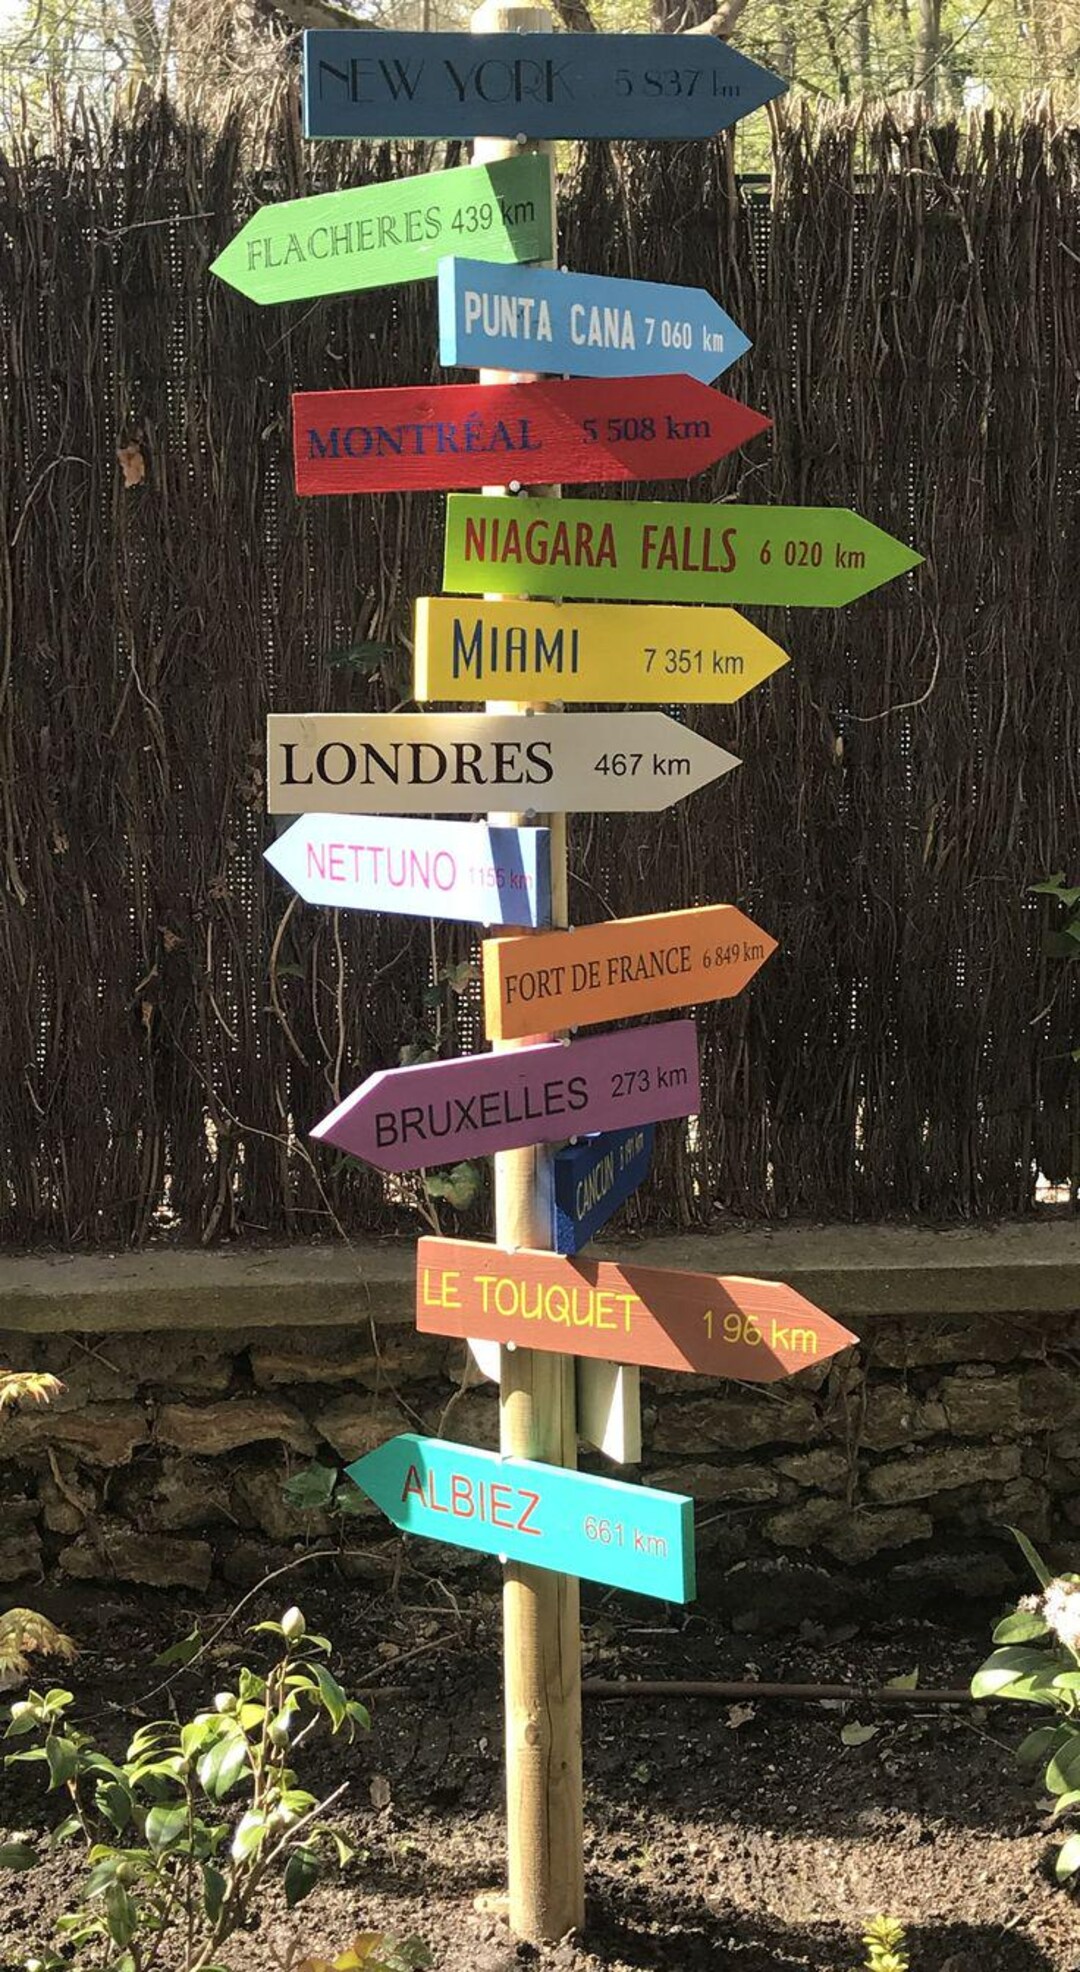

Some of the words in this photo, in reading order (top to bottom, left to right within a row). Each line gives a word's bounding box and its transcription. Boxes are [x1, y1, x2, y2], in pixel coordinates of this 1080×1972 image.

[319, 58, 425, 103] NEW
[443, 59, 577, 104] YORK
[615, 69, 633, 97] 5
[644, 69, 703, 97] 837
[246, 206, 444, 271] FLACHERES
[451, 203, 495, 235] 439
[501, 200, 536, 226] km
[464, 290, 552, 342] PUNTA
[570, 303, 636, 350] CANA
[644, 317, 656, 346] 7
[661, 320, 692, 350] 060
[703, 325, 724, 353] km
[305, 412, 542, 459] MONTRÉAL
[582, 419, 598, 445] 5
[607, 418, 657, 442] 508
[665, 415, 711, 440] km
[464, 517, 618, 568] NIAGARA
[640, 525, 737, 573] FALLS
[759, 539, 772, 566] 6
[784, 540, 823, 568] 020
[835, 543, 866, 570] km
[644, 648, 657, 673] 7
[664, 648, 703, 674] 351
[712, 650, 745, 675] km
[279, 741, 555, 786] LONDRES
[594, 753, 641, 776] 467
[653, 753, 691, 776] km
[306, 842, 457, 892] NETTUNO
[509, 870, 534, 891] km
[504, 966, 566, 1005] FORT
[571, 960, 600, 993] DE
[606, 945, 692, 987] FRANCE
[702, 952, 712, 969] 6
[714, 947, 740, 968] 849
[743, 940, 765, 963] km
[374, 1076, 589, 1148] BRUXELLES
[610, 1069, 650, 1098] 273
[656, 1066, 688, 1089] km
[423, 1268, 462, 1308] LE
[474, 1275, 642, 1332] TOUQUET
[770, 1318, 818, 1354] km
[401, 1464, 542, 1536] ALBIEZ
[584, 1515, 624, 1546] 661
[633, 1527, 668, 1559] km
